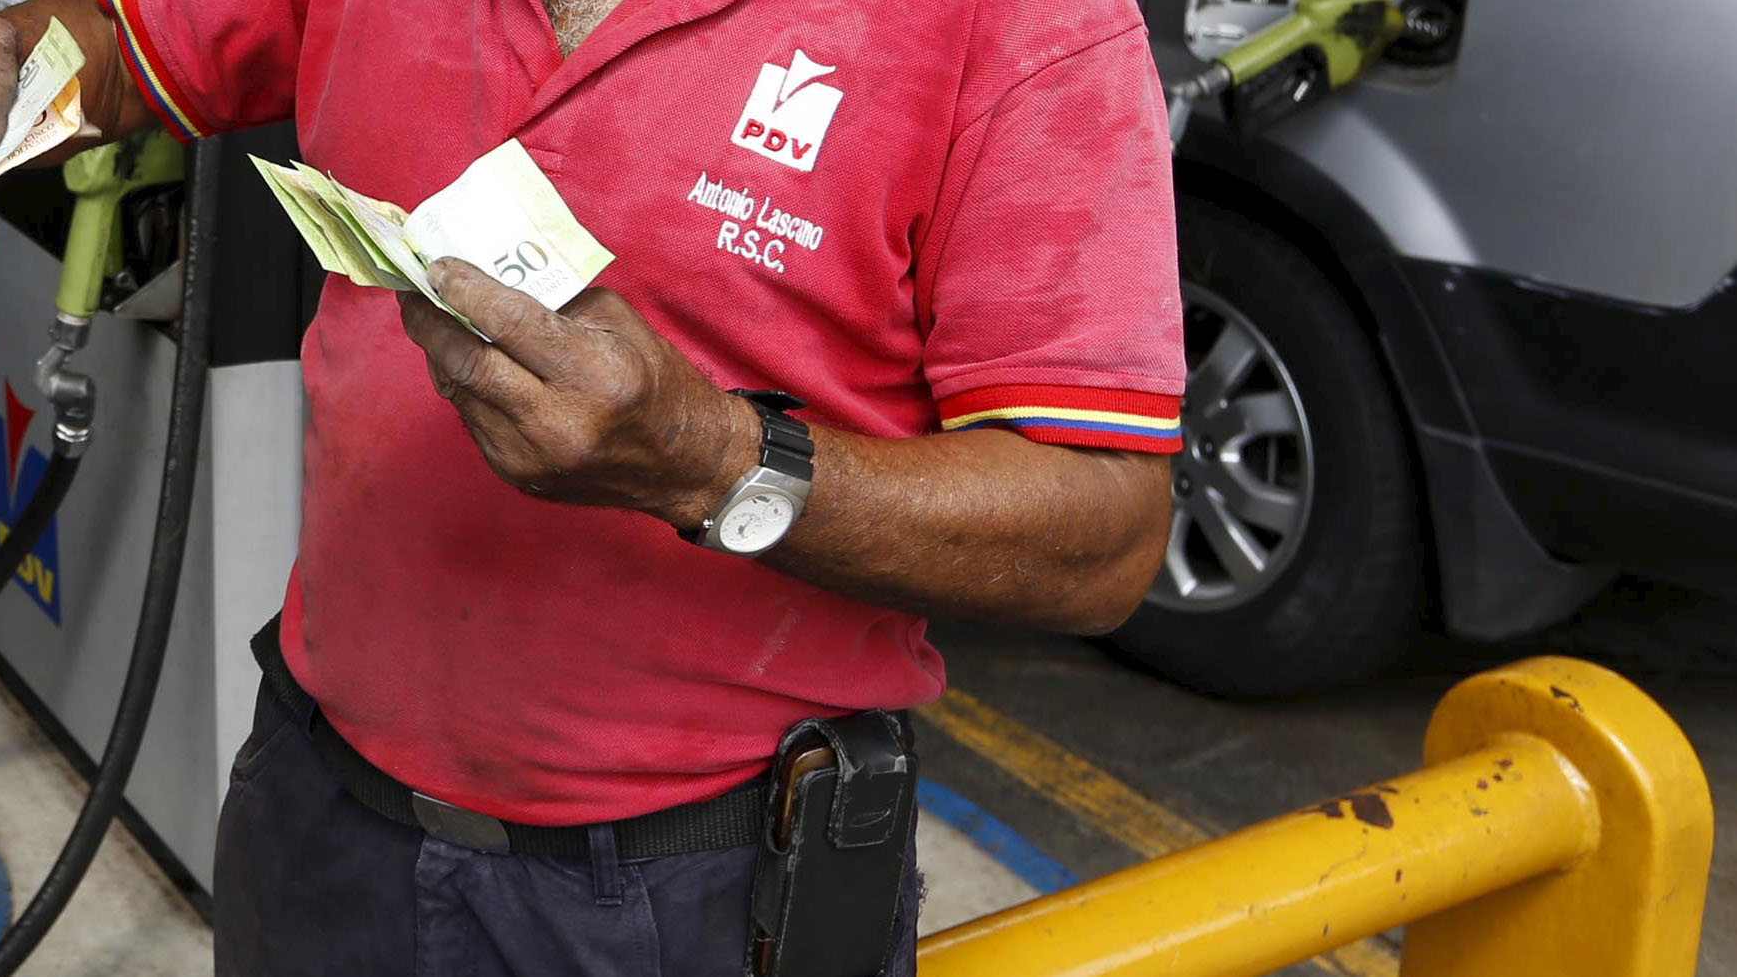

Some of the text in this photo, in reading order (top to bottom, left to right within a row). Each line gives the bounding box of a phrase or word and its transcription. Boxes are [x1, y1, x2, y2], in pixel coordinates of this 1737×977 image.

[24, 122, 55, 145] CINCO
[741, 118, 812, 160] PDV
[687, 171, 824, 251] Antonio Lascano
[493, 240, 549, 288] 50
